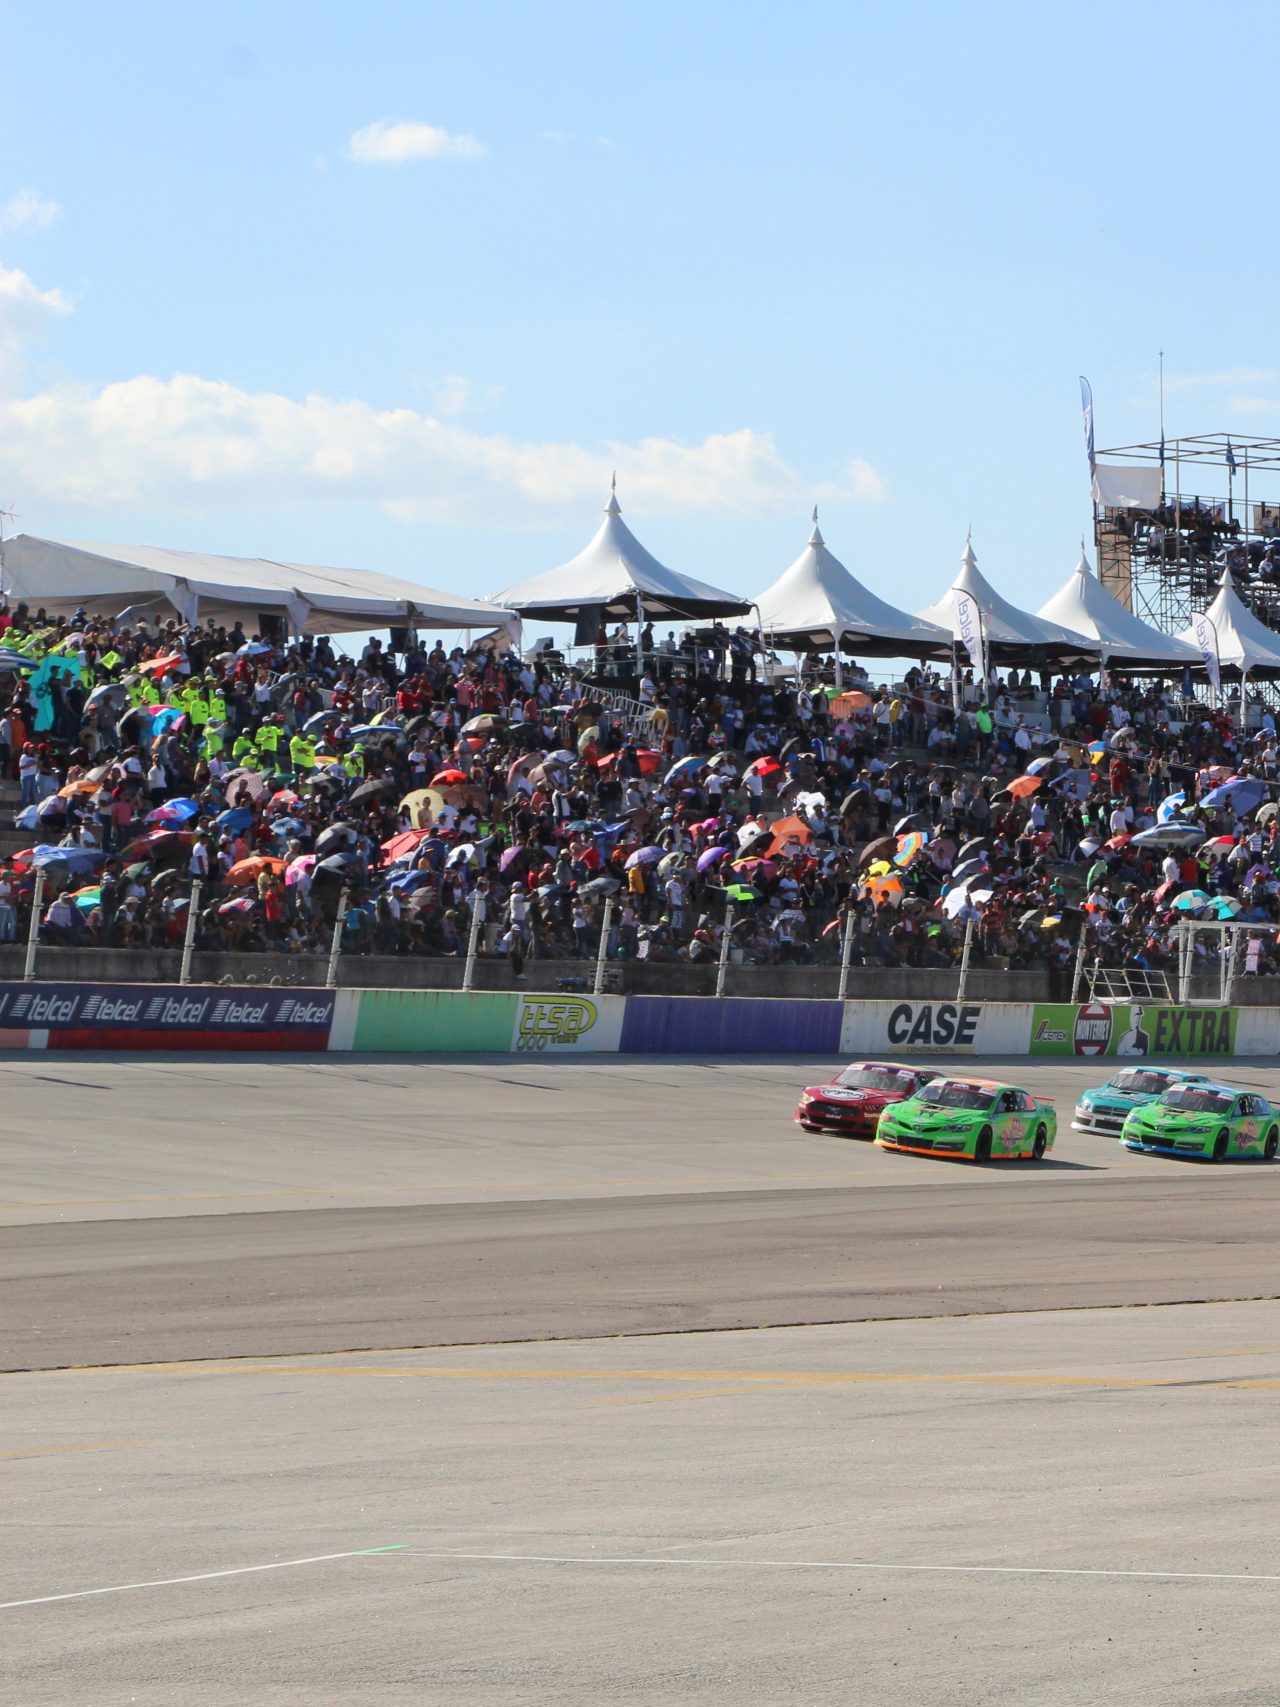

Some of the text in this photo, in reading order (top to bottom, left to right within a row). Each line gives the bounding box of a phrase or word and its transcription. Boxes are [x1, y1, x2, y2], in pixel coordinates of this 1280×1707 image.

[27, 994, 80, 1021] telcel
[95, 998, 142, 1021] telcel
[161, 997, 210, 1023] telcel
[224, 1002, 269, 1023] telcel
[289, 1002, 332, 1023] telcel
[887, 1003, 982, 1045] CASE
[1077, 1019, 1111, 1041] MONTERREY
[1154, 1010, 1231, 1053] EXTRA
